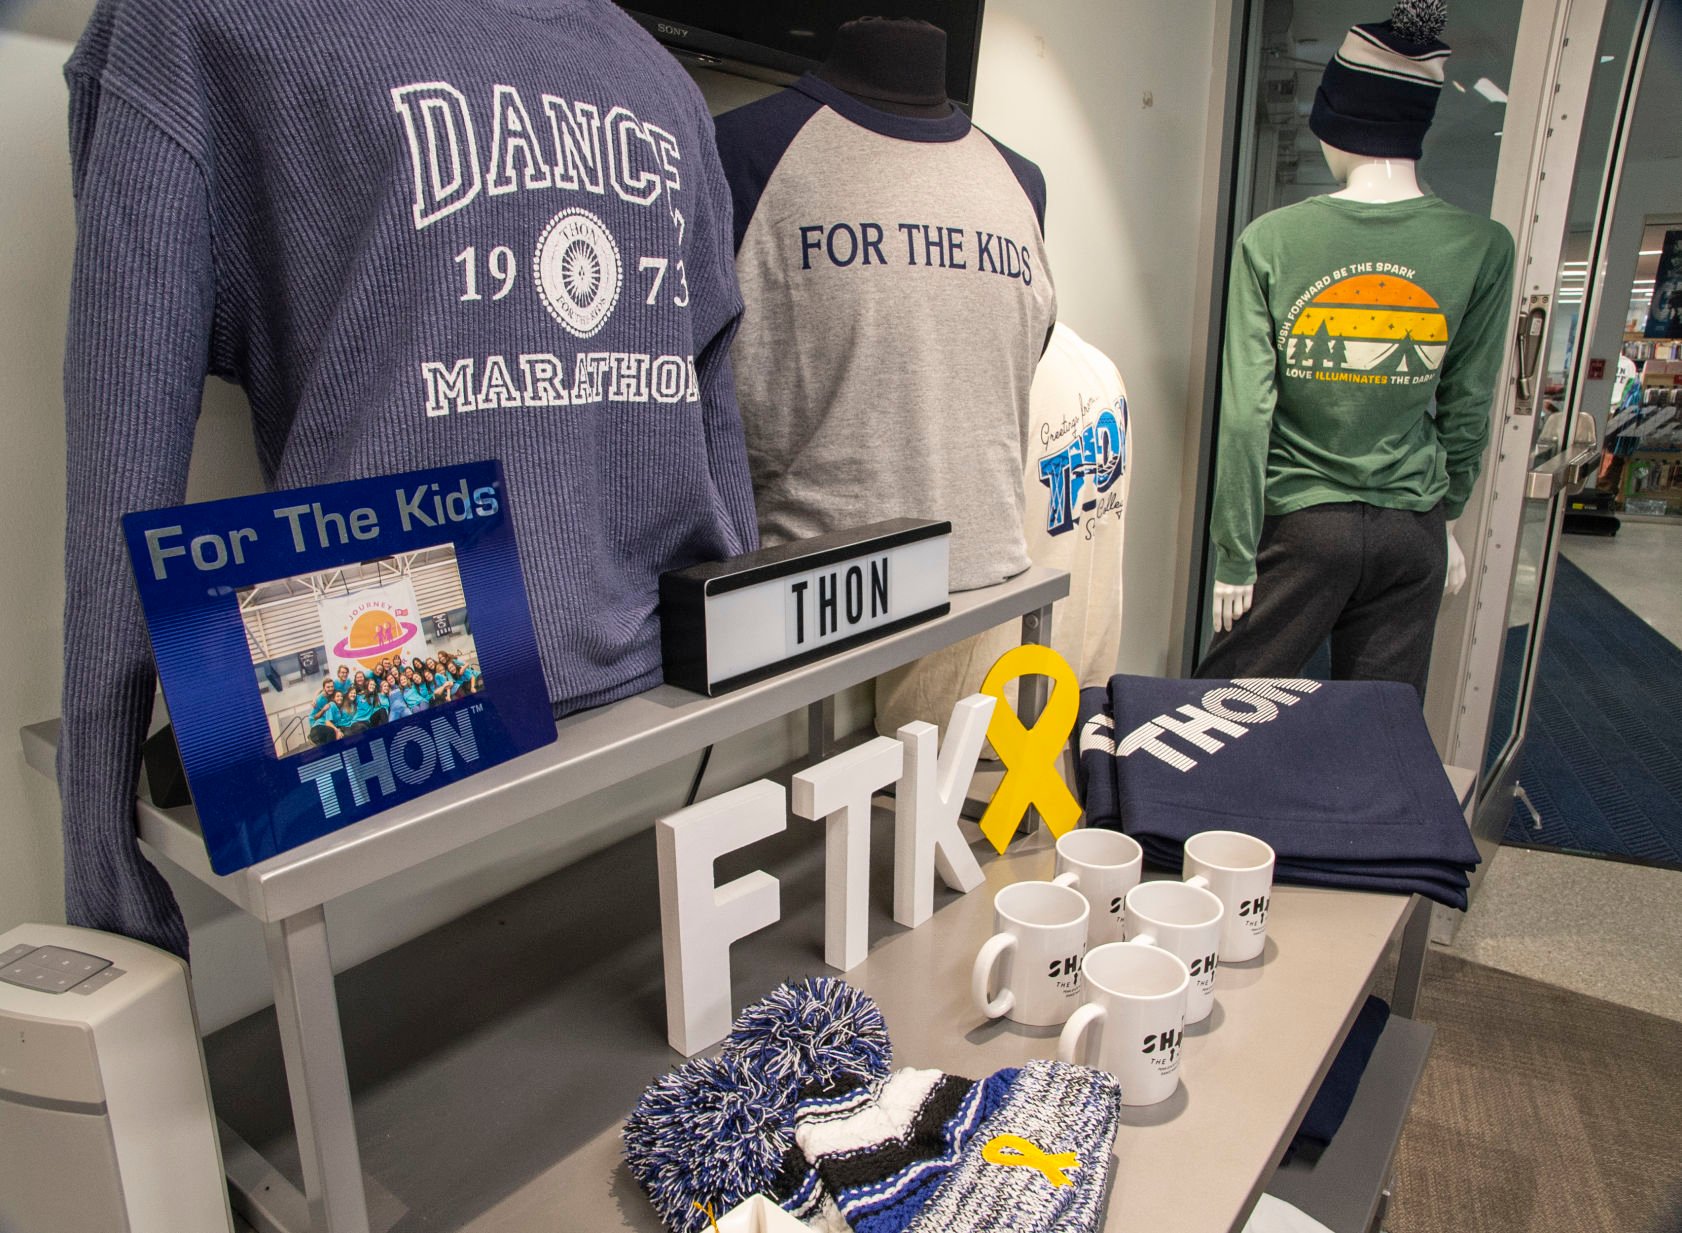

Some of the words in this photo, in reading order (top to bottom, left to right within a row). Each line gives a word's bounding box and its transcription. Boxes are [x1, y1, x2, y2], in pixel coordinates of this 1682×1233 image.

[657, 23, 689, 38] SONY
[390, 81, 686, 246] DANCE
[560, 221, 598, 245] THON
[799, 222, 888, 270] FOR
[898, 223, 967, 270] THE
[975, 230, 1033, 287] KIDS
[454, 246, 517, 301] 19
[638, 257, 690, 307] 73
[1277, 321, 1292, 351] PUSH
[1287, 275, 1331, 320] FORWARD
[1332, 267, 1348, 280] BE
[1350, 262, 1373, 274] THE
[1376, 262, 1416, 279] SPARK
[1285, 367, 1313, 380] LOVE
[1315, 371, 1388, 385] ILLUMINATES
[1390, 375, 1410, 385] THE
[144, 524, 258, 581] For
[273, 502, 381, 554] The
[395, 478, 500, 533] Kids
[349, 600, 393, 622] JOURNEY
[791, 556, 889, 645] THON
[298, 707, 481, 819] THON
[1151, 1057, 1167, 1065] THE
